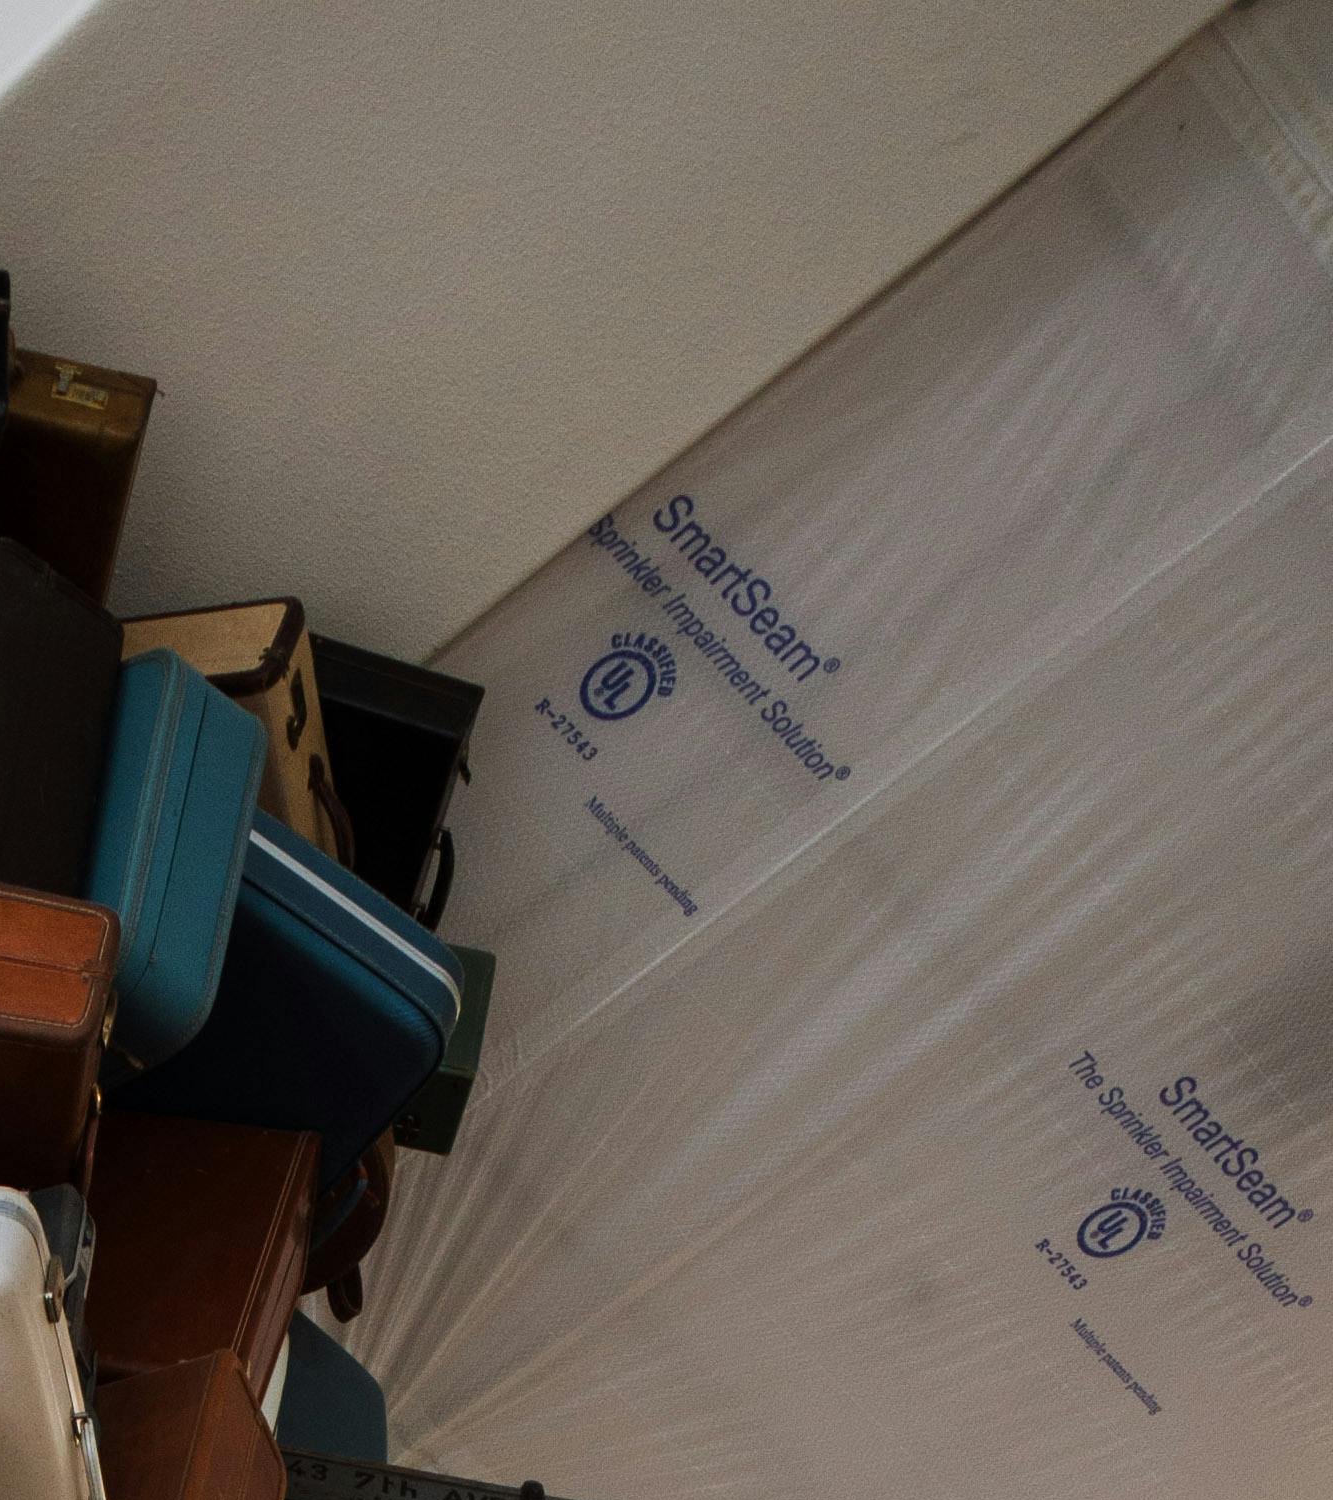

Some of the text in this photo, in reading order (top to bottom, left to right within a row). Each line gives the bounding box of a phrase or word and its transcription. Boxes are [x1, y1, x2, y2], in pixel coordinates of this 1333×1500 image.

[587, 514, 672, 600] Sprinkler
[662, 593, 771, 707] Impairment
[611, 632, 678, 699] CLASSIFIED
[534, 697, 599, 762] R-27543
[624, 840, 661, 879] patents
[657, 872, 699, 917] pending
[1068, 1050, 1106, 1091] The
[1098, 1086, 1170, 1162] Sprinkler
[1159, 1156, 1249, 1249] Impairment
[1110, 1187, 1167, 1241] CLASSIFIED
[1035, 1238, 1088, 1291] R-27543
